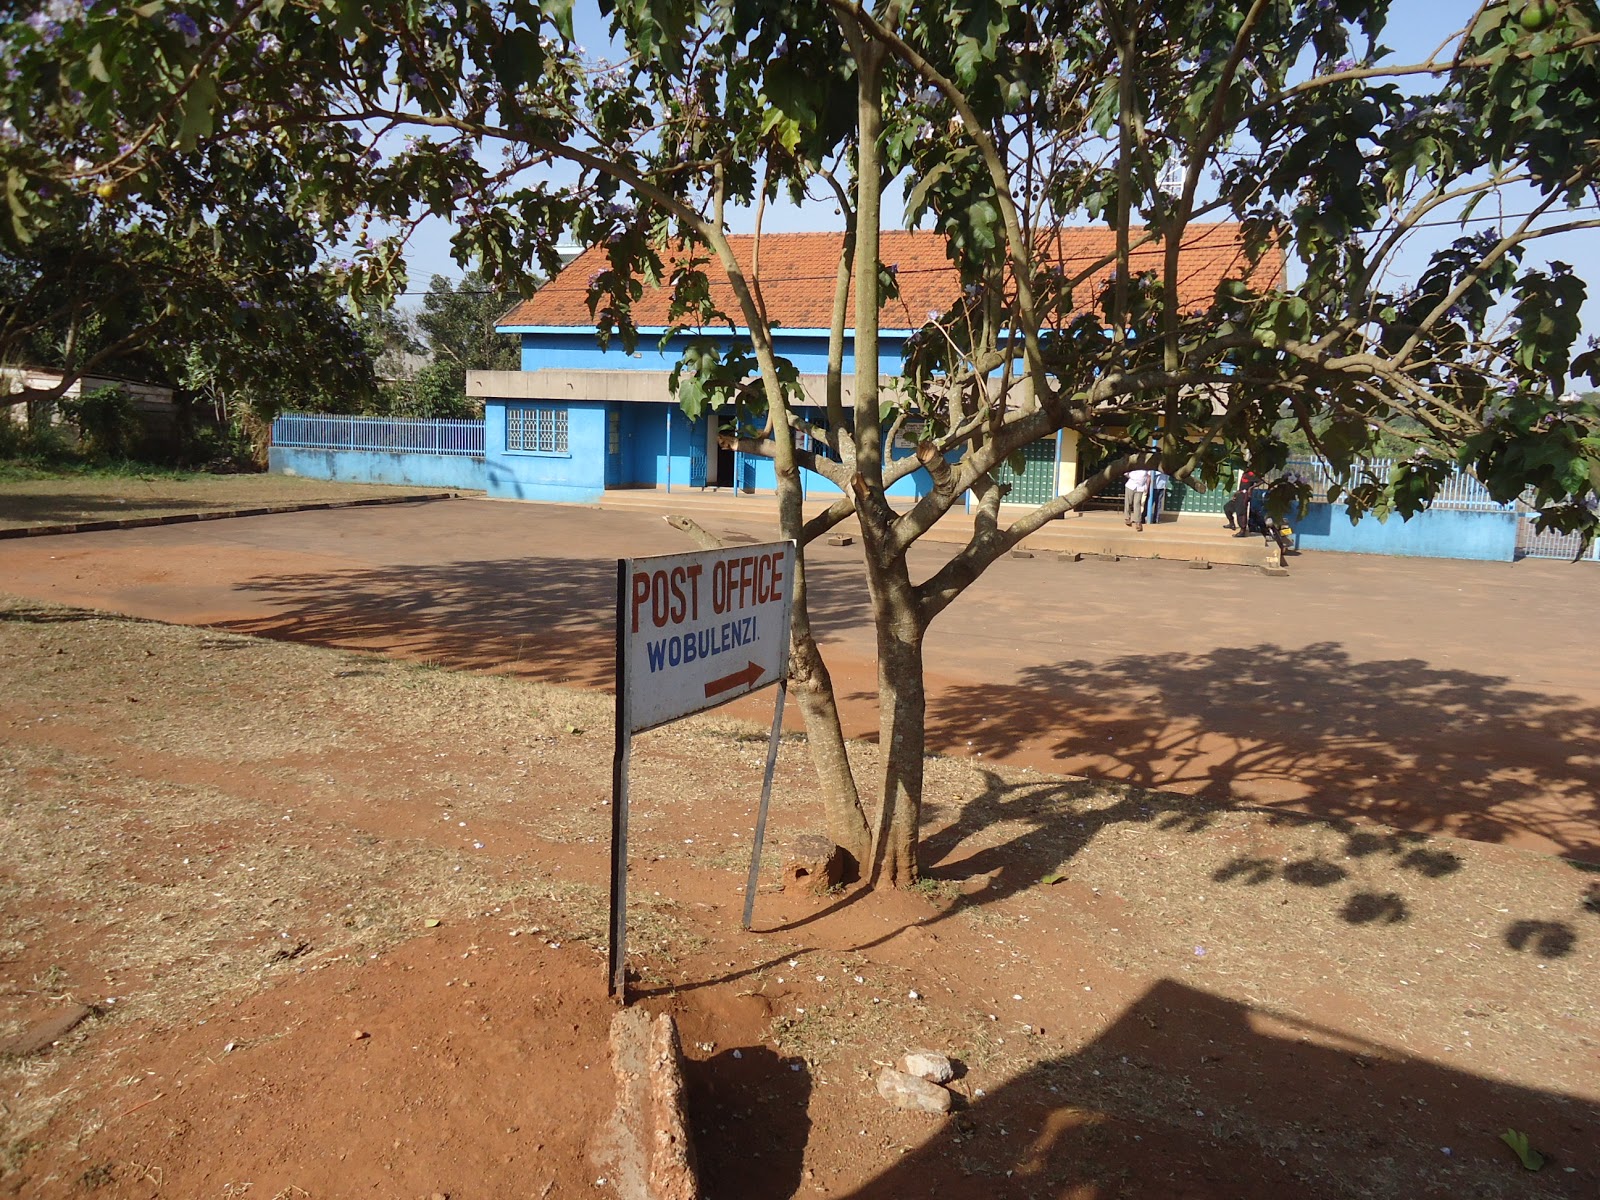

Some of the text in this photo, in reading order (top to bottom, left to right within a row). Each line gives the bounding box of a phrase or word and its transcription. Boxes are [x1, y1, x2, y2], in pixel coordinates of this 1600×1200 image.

[632, 551, 784, 633] POST OFFICE
[647, 616, 760, 673] WOBULENZI.
